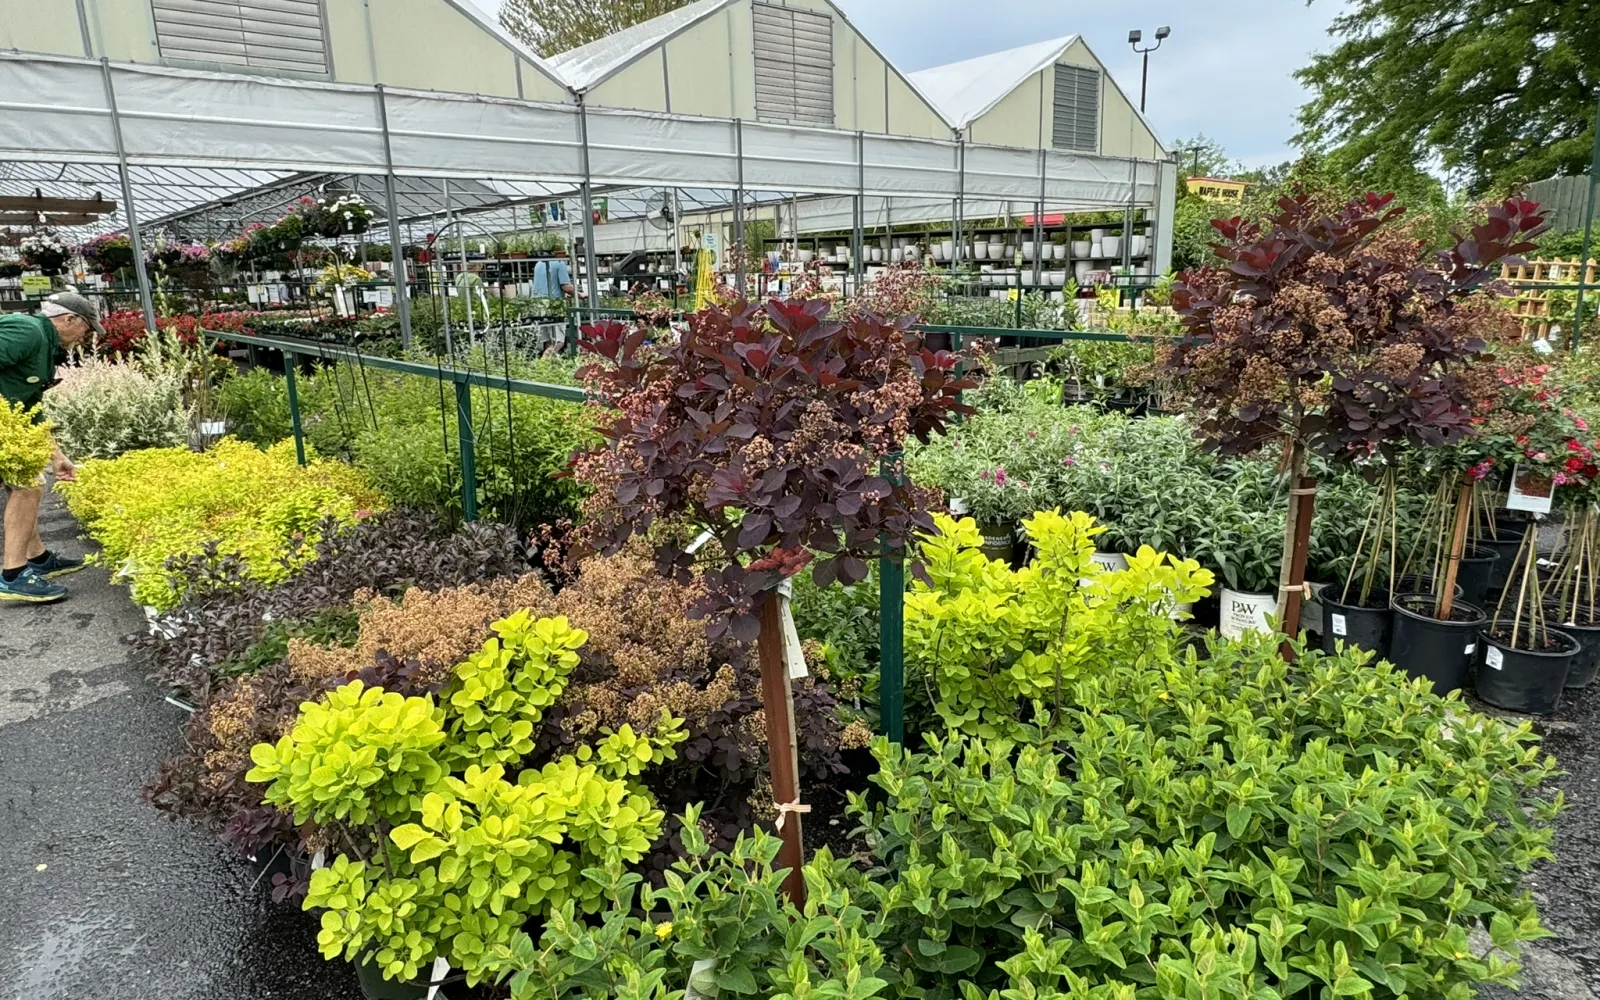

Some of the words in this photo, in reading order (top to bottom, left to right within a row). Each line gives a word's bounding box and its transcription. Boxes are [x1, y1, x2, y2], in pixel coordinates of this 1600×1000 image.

[1199, 186, 1220, 198] WAFFLE
[1222, 188, 1239, 198] HOUSE
[1231, 600, 1257, 615] PW
